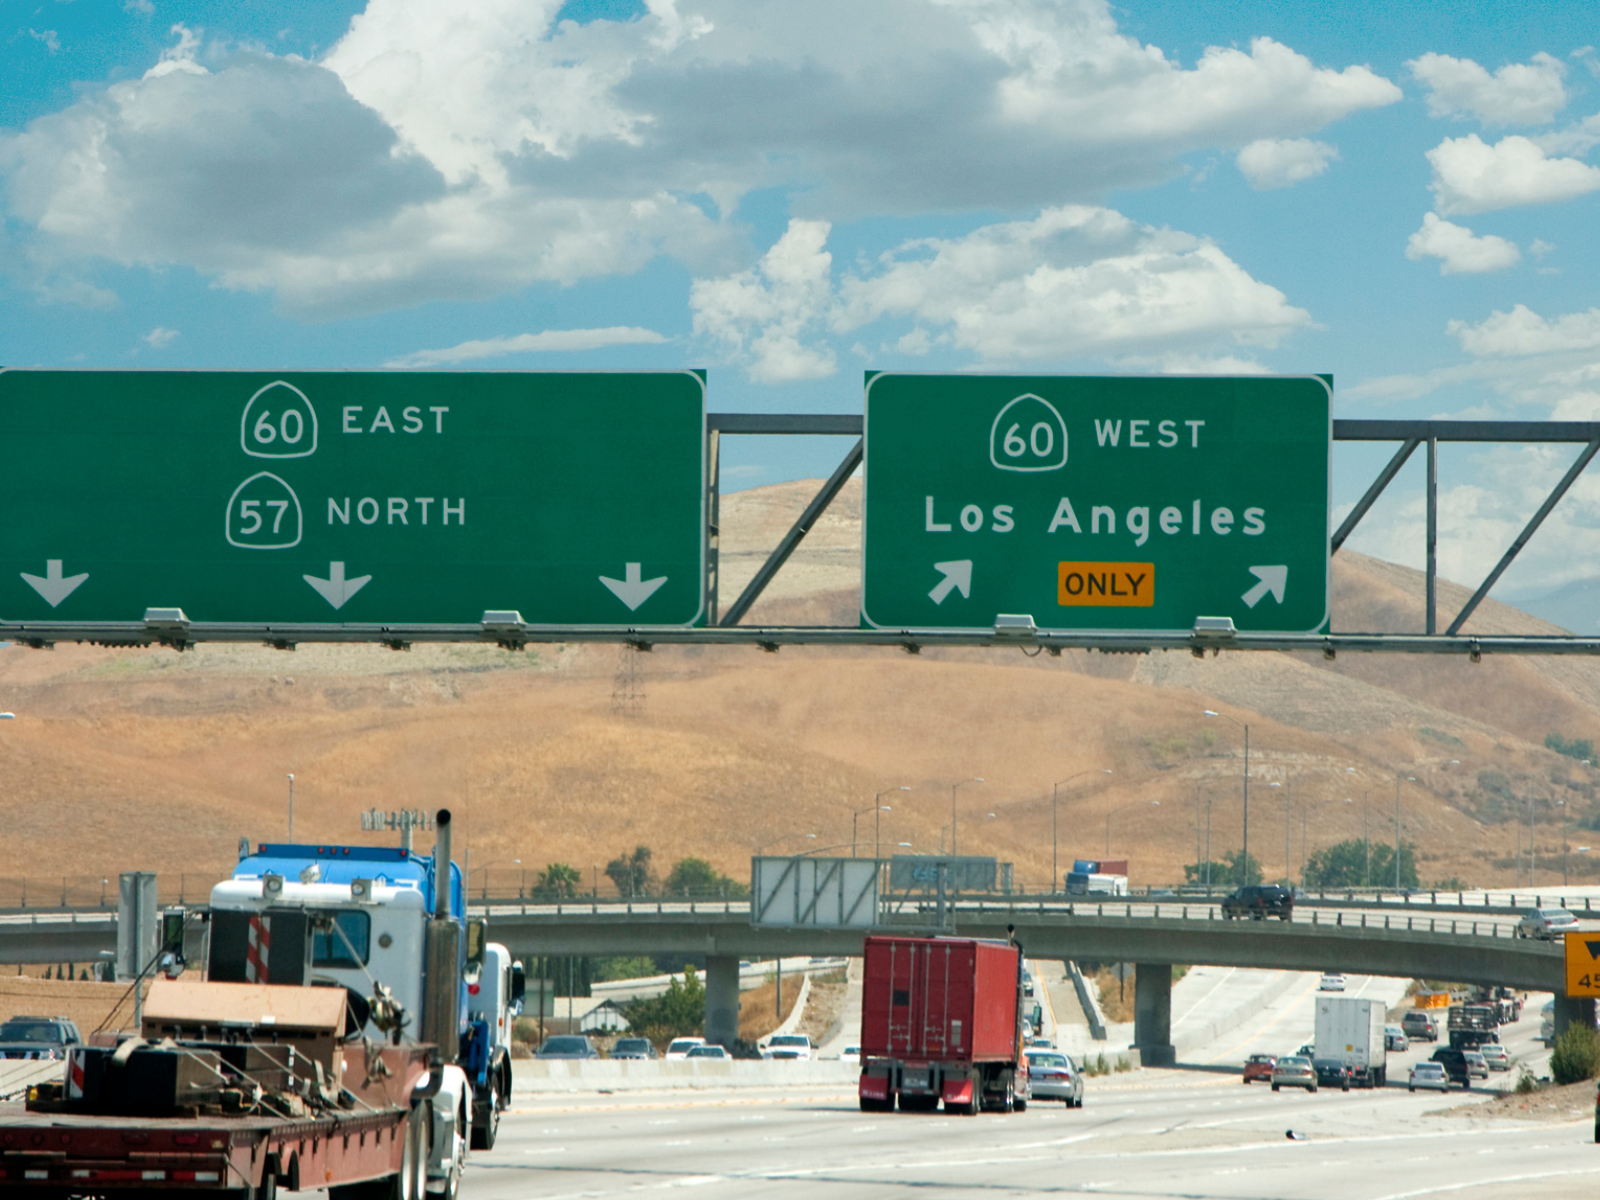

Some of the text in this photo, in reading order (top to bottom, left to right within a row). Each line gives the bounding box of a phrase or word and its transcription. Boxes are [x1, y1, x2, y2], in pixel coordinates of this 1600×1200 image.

[254, 406, 450, 444] 60 EAST
[1003, 420, 1205, 457] 60 WEST
[240, 497, 465, 534] 57 NORTH
[925, 496, 1265, 547] Los Angeles
[1065, 572, 1146, 596] ONLY
